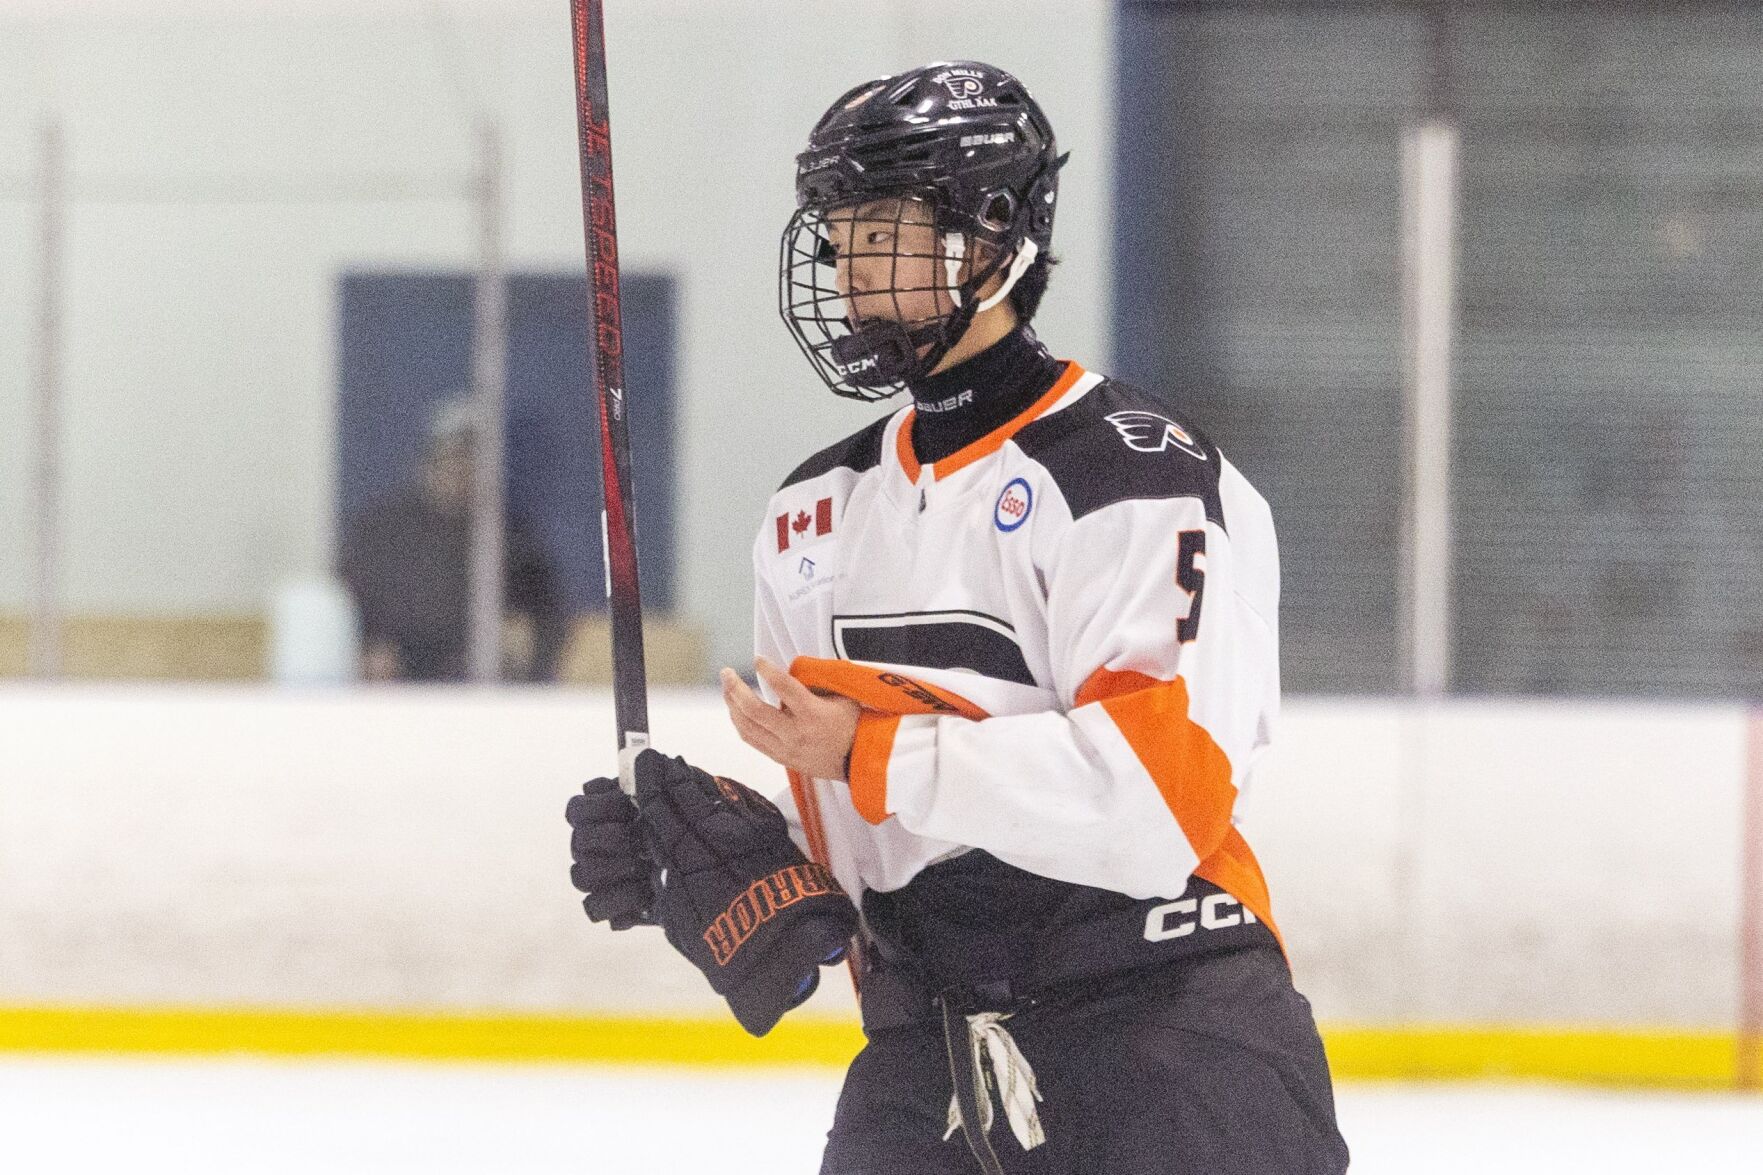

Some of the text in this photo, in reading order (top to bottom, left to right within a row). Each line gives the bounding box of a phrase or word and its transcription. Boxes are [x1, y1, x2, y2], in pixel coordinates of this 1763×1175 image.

[837, 354, 879, 376] CCM
[1001, 489, 1026, 517] Esso
[1175, 529, 1206, 645] 5
